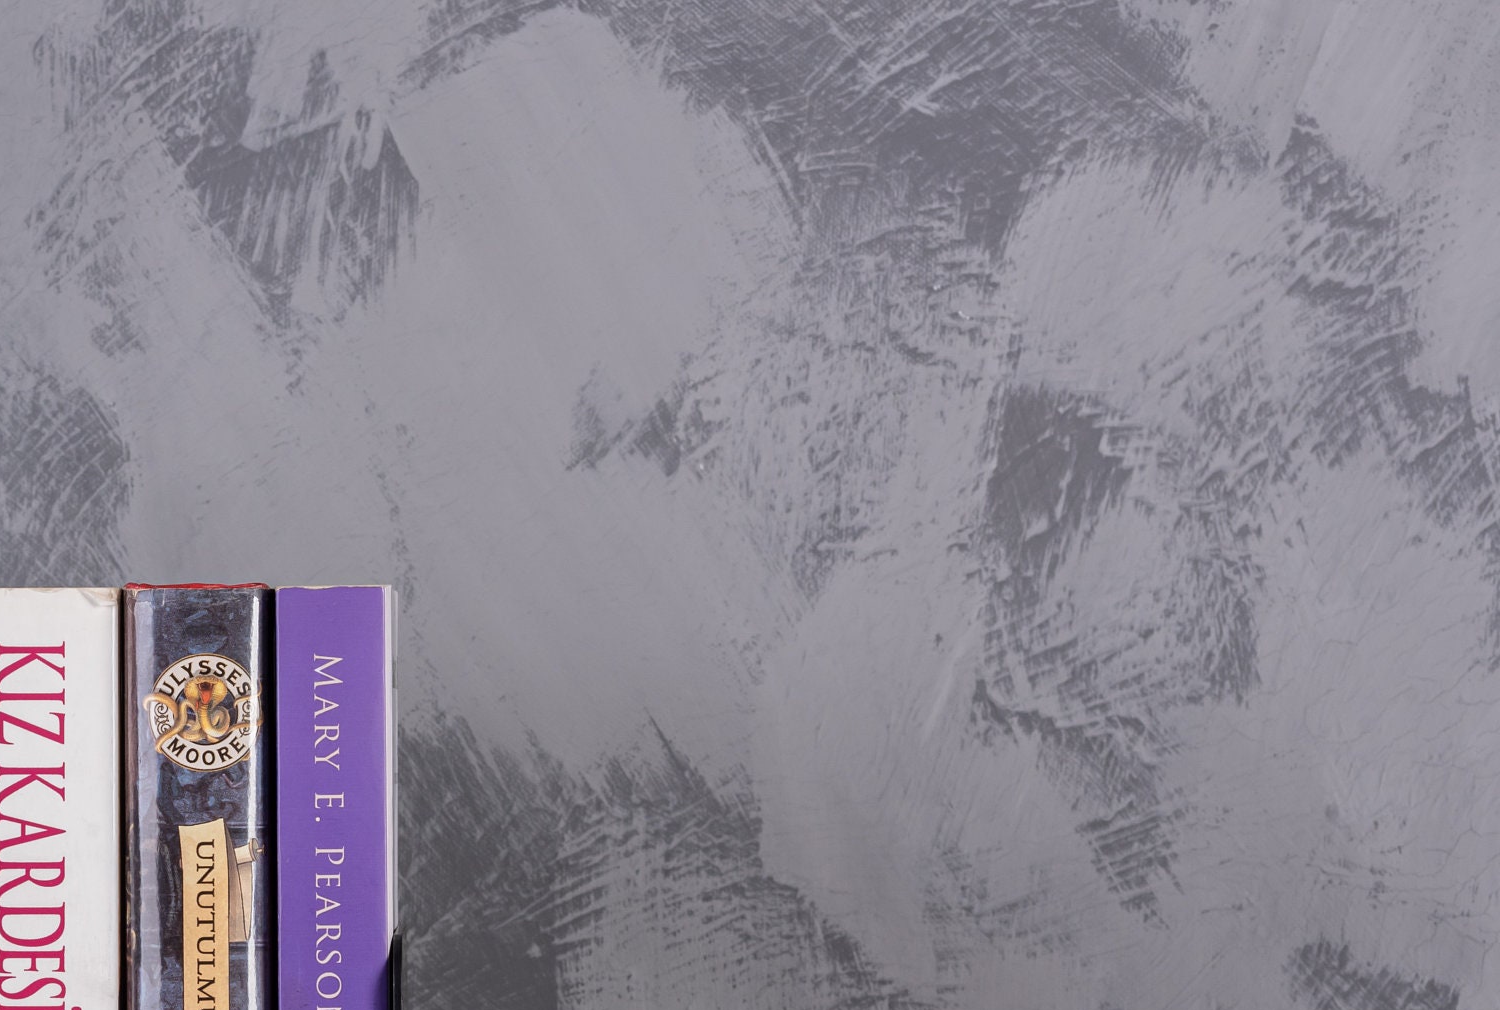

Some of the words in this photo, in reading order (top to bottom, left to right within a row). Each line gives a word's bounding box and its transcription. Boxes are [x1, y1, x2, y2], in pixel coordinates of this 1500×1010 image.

[158, 659, 251, 697] ULYSSES
[313, 653, 344, 771] MARY
[167, 737, 246, 767] MOORE
[313, 791, 346, 824] E.
